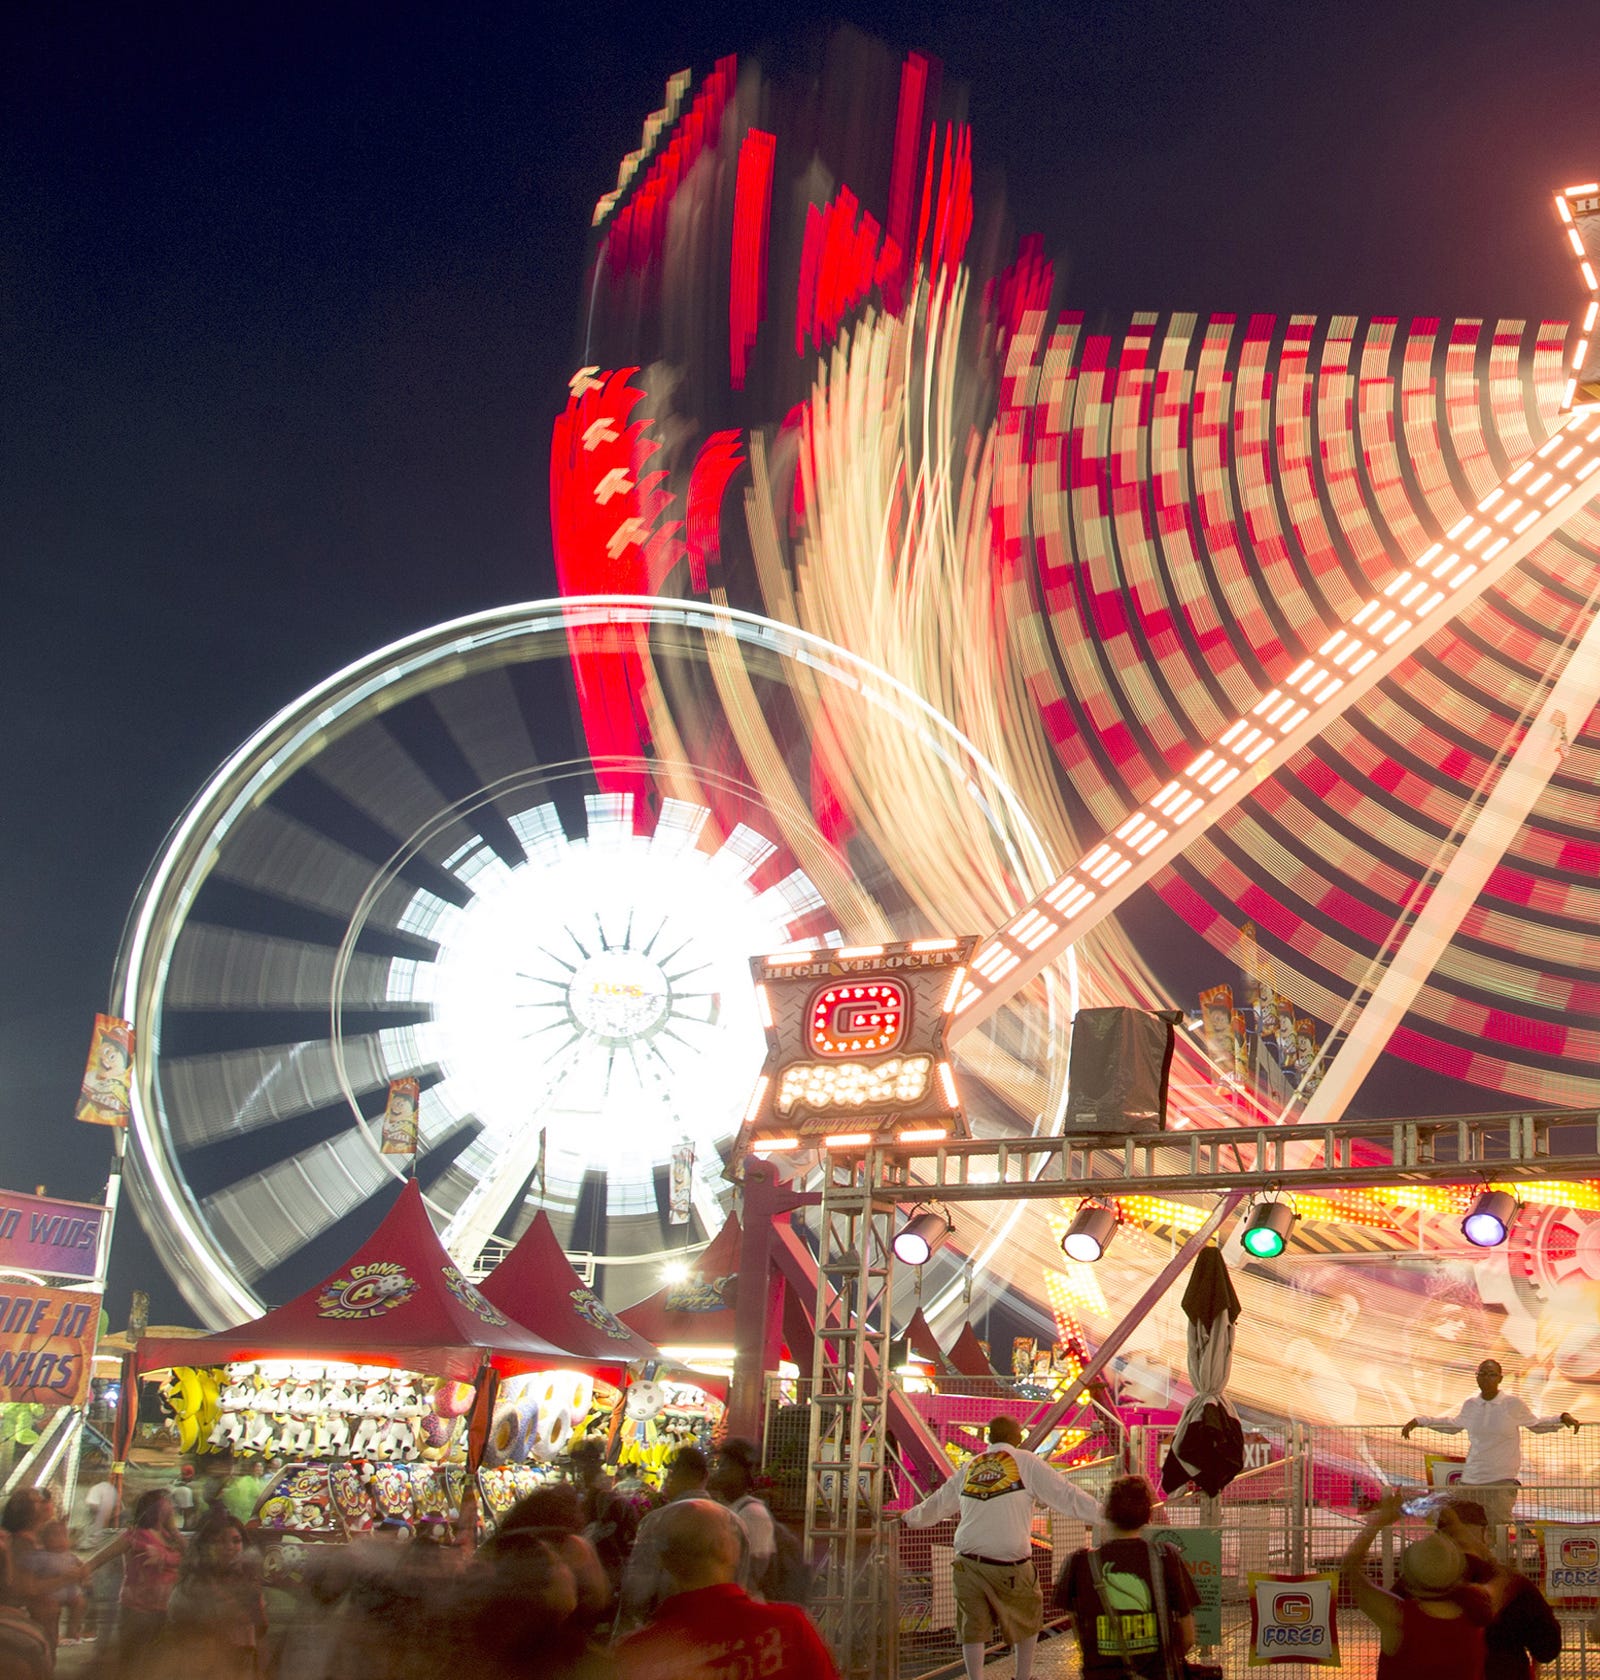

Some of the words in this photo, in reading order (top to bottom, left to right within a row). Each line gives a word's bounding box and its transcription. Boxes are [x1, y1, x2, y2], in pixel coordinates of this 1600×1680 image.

[763, 959, 830, 980] HIGH
[840, 952, 966, 973] VELOCITY
[808, 977, 906, 1059] G
[778, 1056, 931, 1114] FORCE
[29, 1211, 99, 1250] WINS
[350, 1262, 407, 1280] BANK
[351, 1283, 376, 1301] A
[52, 1301, 93, 1339] IN
[317, 1309, 387, 1320] BALL
[1243, 1443, 1272, 1468] XIT
[1560, 1537, 1600, 1568] G
[1273, 1592, 1313, 1626] G
[1263, 1625, 1325, 1648] FORCE
